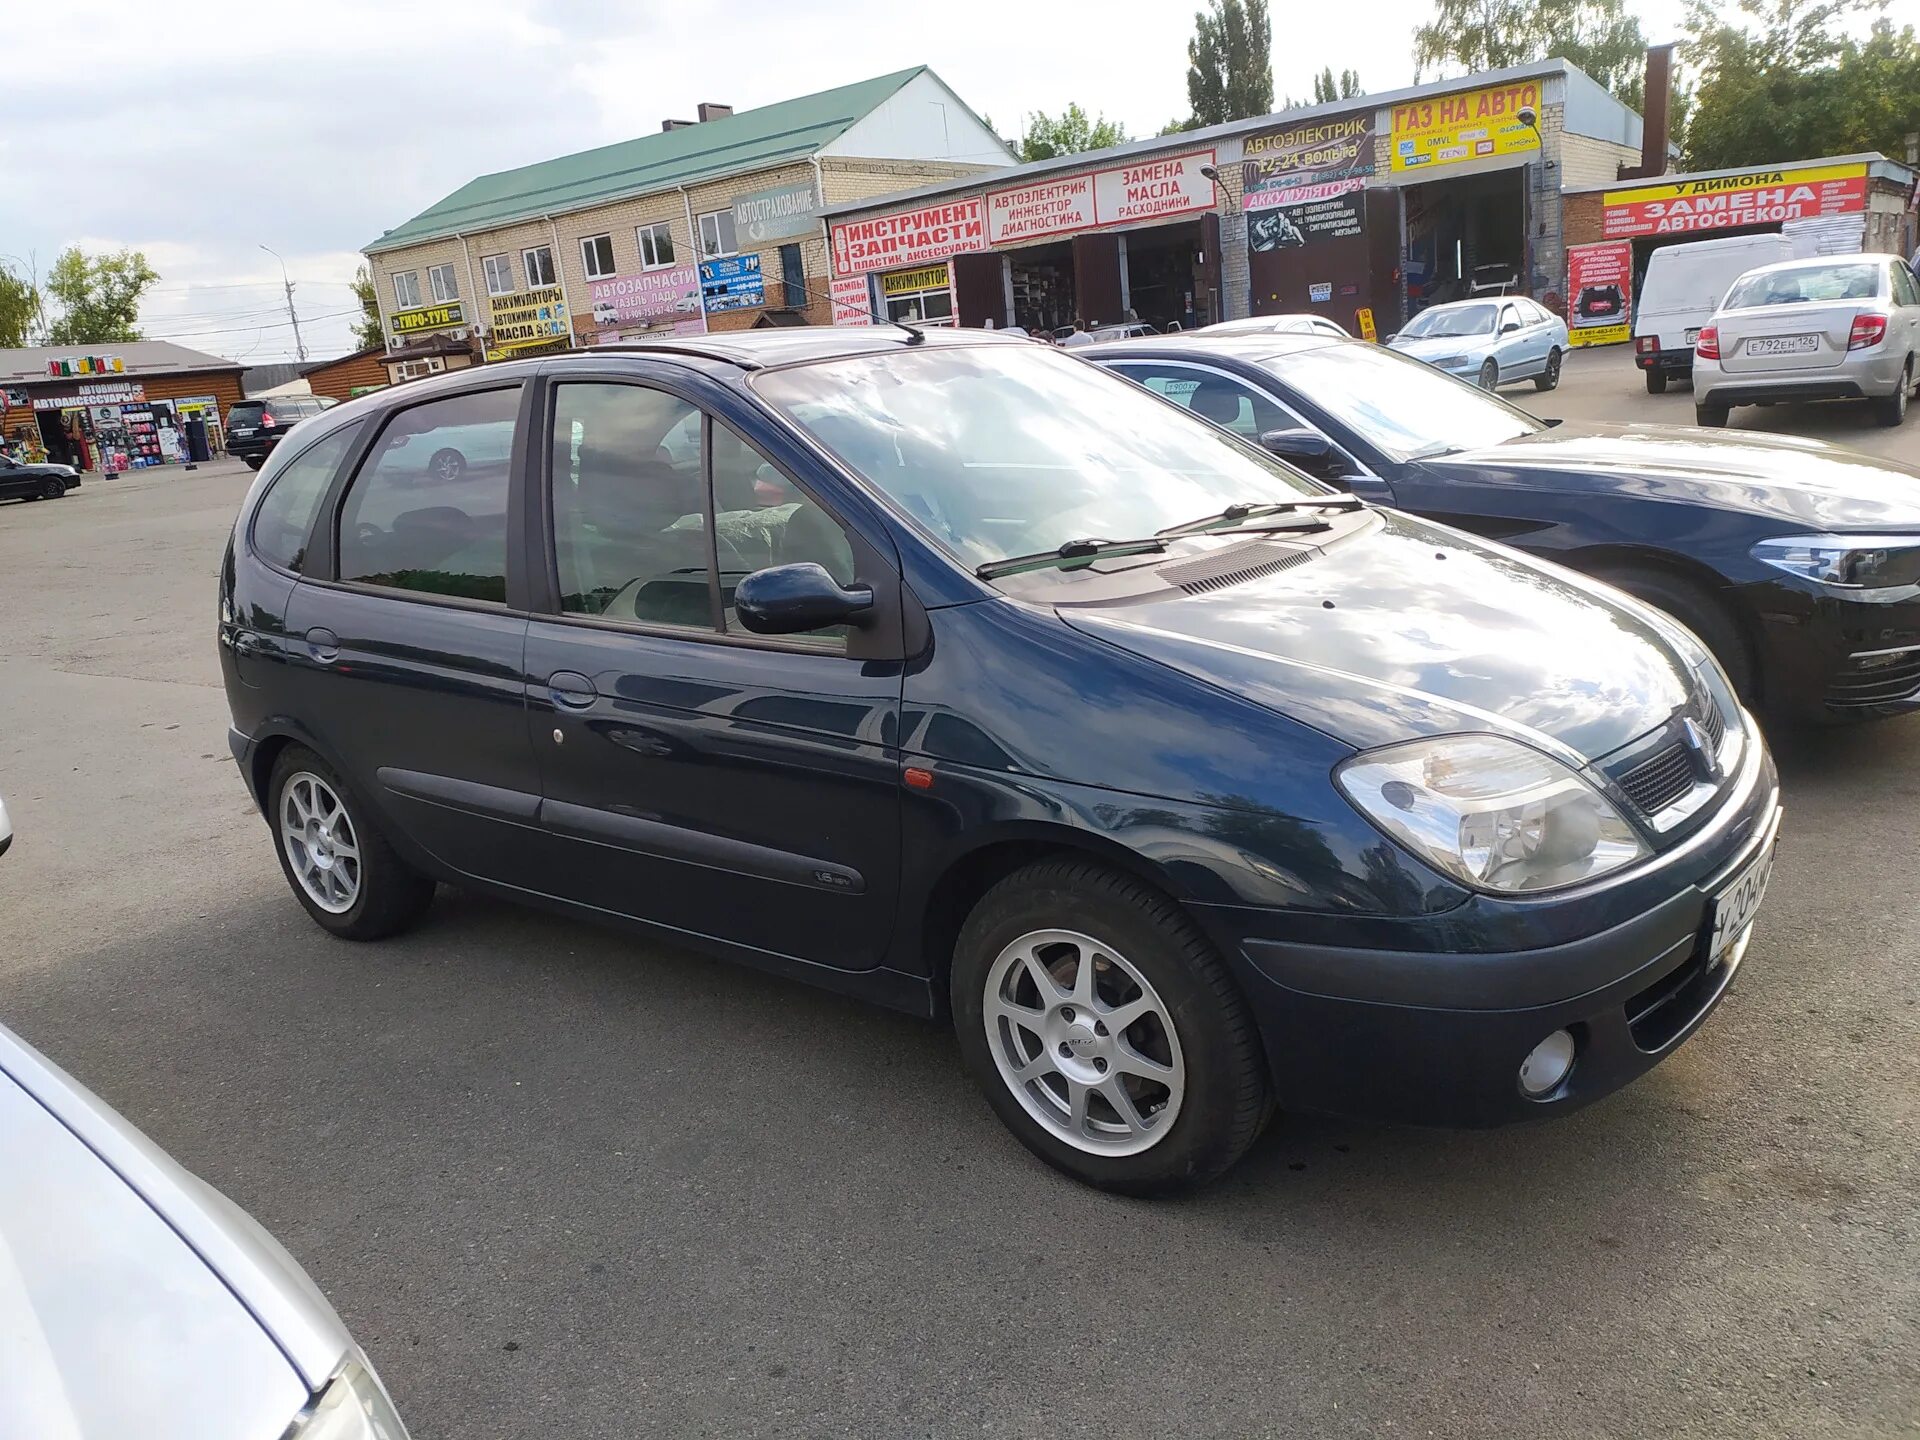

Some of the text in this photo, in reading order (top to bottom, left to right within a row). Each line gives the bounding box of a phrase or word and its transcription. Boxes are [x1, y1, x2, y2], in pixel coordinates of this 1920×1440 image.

[1394, 84, 1537, 133] ГАЗ НА АВТО
[1245, 118, 1367, 155] АВТОЭЛЕКТРИК
[1426, 135, 1452, 148] OMVL
[1122, 161, 1184, 187] ЗАМЕНА
[1259, 152, 1300, 174] 12-24
[994, 180, 1087, 210] АВТОЭЛЕКТРИК
[1127, 180, 1181, 203] МАСЛА
[1675, 172, 1785, 195] У ДИМОНА
[736, 189, 814, 225] АВТОСТРАХОВАНИЕ
[1008, 198, 1072, 220] ИНЖЕКТОР
[1118, 195, 1190, 218] РАСХОДНИКИ
[1643, 185, 1817, 219] ЗАМЕНА
[849, 201, 979, 243] ИНСТРУМЕНТ
[1001, 210, 1083, 238] ДИАГНОСТИКА
[1656, 203, 1802, 234] АВТОСТЕКОЛ
[850, 220, 981, 259] ЗАПЧАСТИ
[906, 239, 981, 262] АКСЕССУАРЫ
[595, 269, 696, 299] АВТОЗАПЧАСТИ
[833, 278, 866, 294] ЛАМПЫ
[492, 287, 563, 312] АККУМУЛЯТОРЫ
[614, 296, 648, 310] ГАЗЕЛЬ
[650, 289, 679, 305] ЛАДА
[494, 308, 538, 327] АВТОХИМИЯ
[496, 324, 535, 342] МАСЛА
[1797, 336, 1815, 346] 126
[33, 392, 134, 410] АВТОАКСЕССУАРЫ
